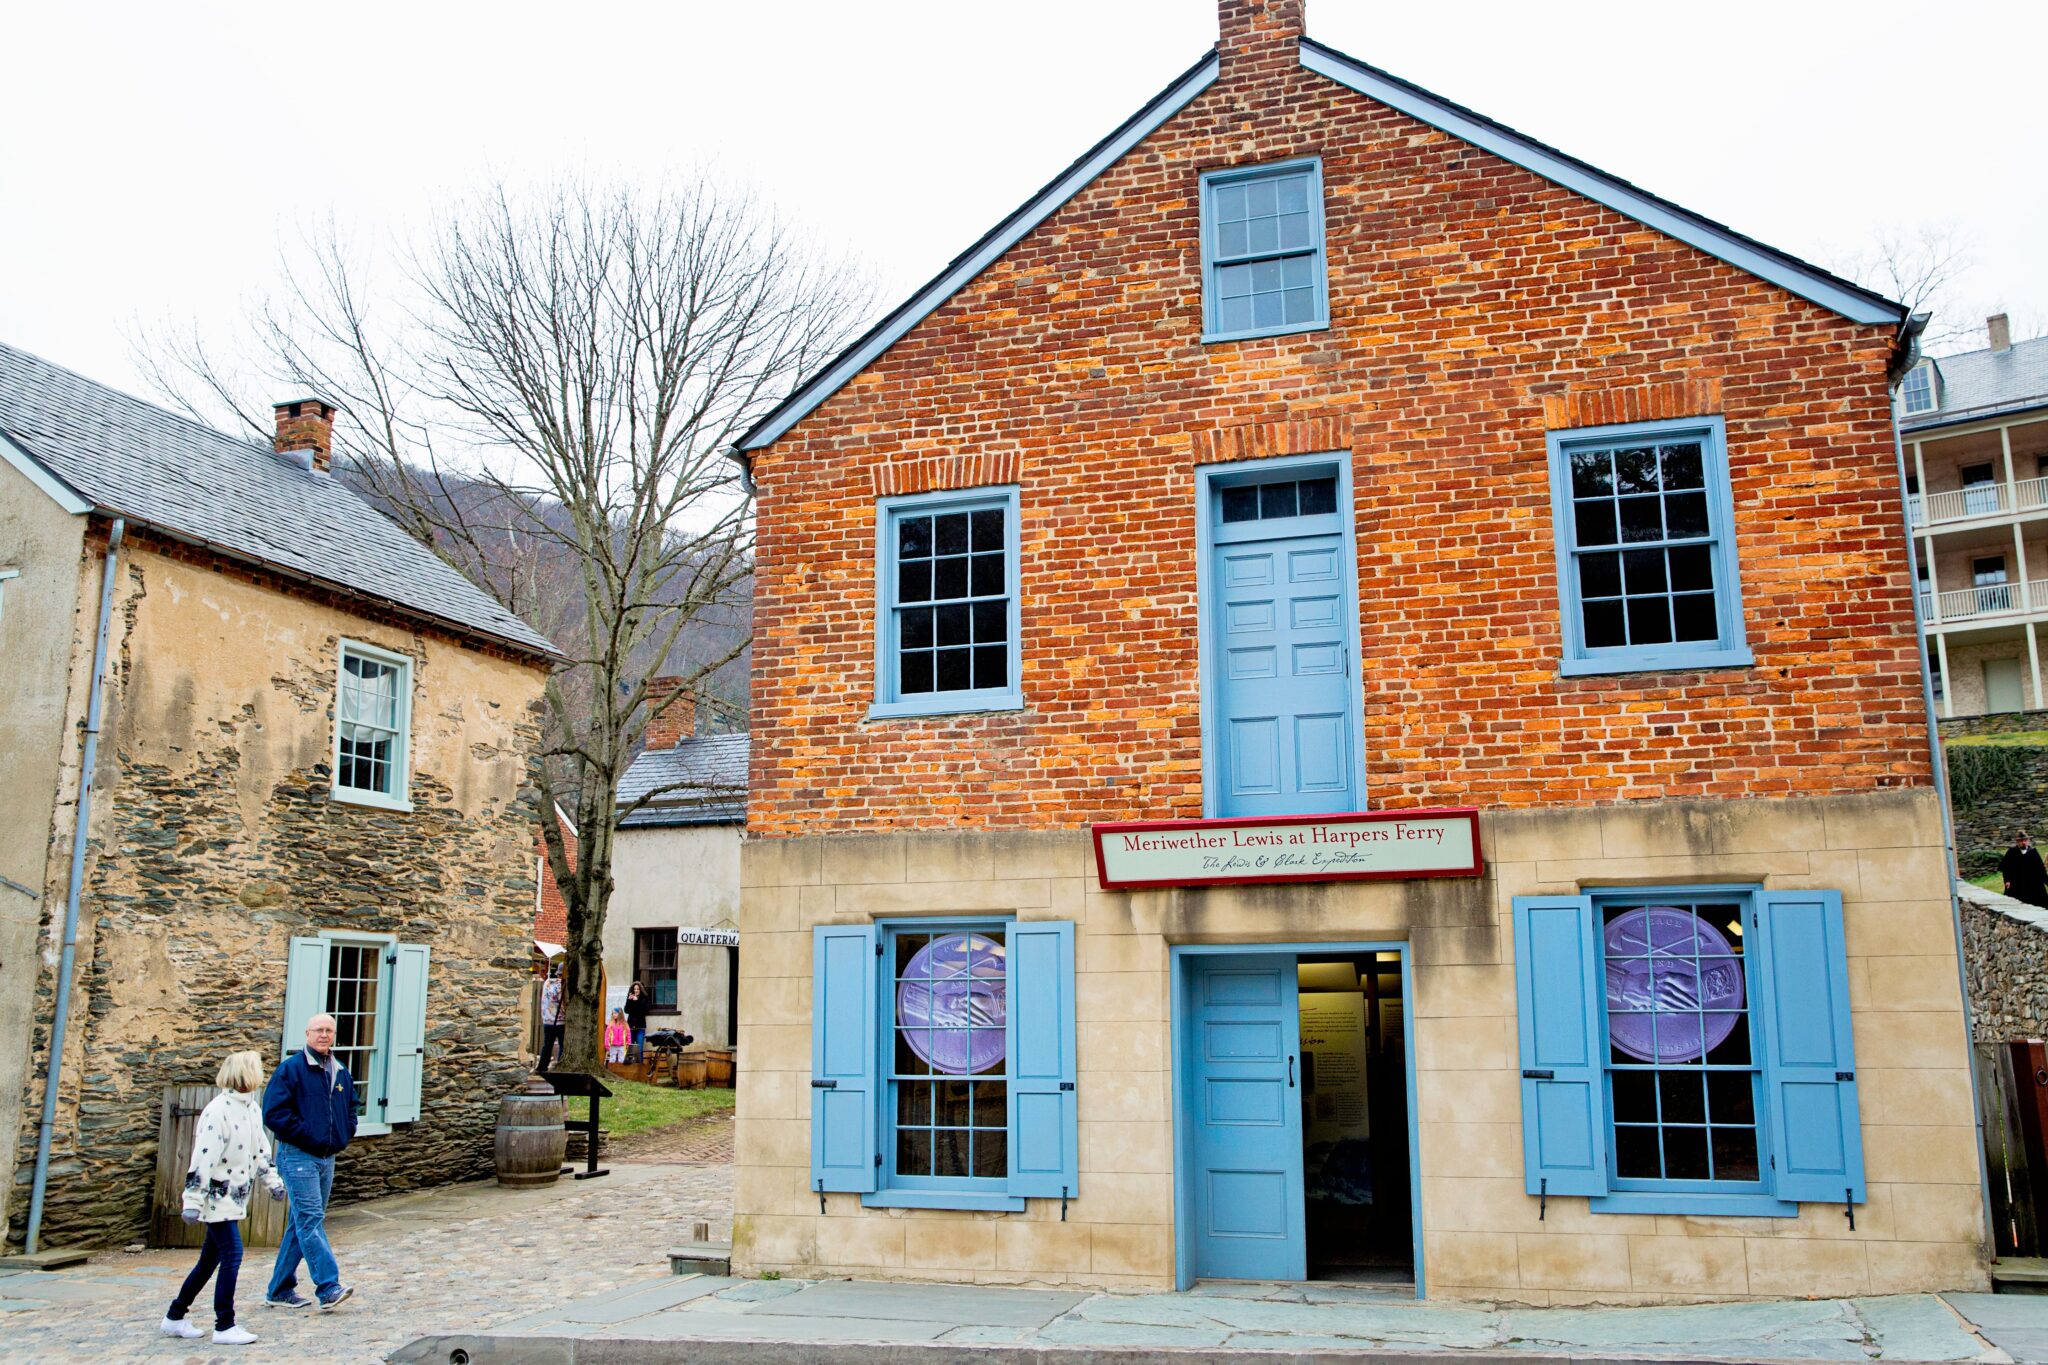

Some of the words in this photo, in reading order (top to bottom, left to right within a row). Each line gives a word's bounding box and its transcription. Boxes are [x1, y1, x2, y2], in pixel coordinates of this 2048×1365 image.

[1122, 831, 1227, 852] Meriwether
[1231, 830, 1283, 847] Lewis
[1289, 831, 1305, 845] at
[1312, 826, 1389, 848] Harpers
[1395, 823, 1445, 845] Ferry
[1203, 855, 1220, 869] The
[1220, 855, 1251, 872] Lewis
[1255, 854, 1269, 868] &
[1274, 853, 1306, 868] Clark
[1312, 851, 1373, 873] Expedition
